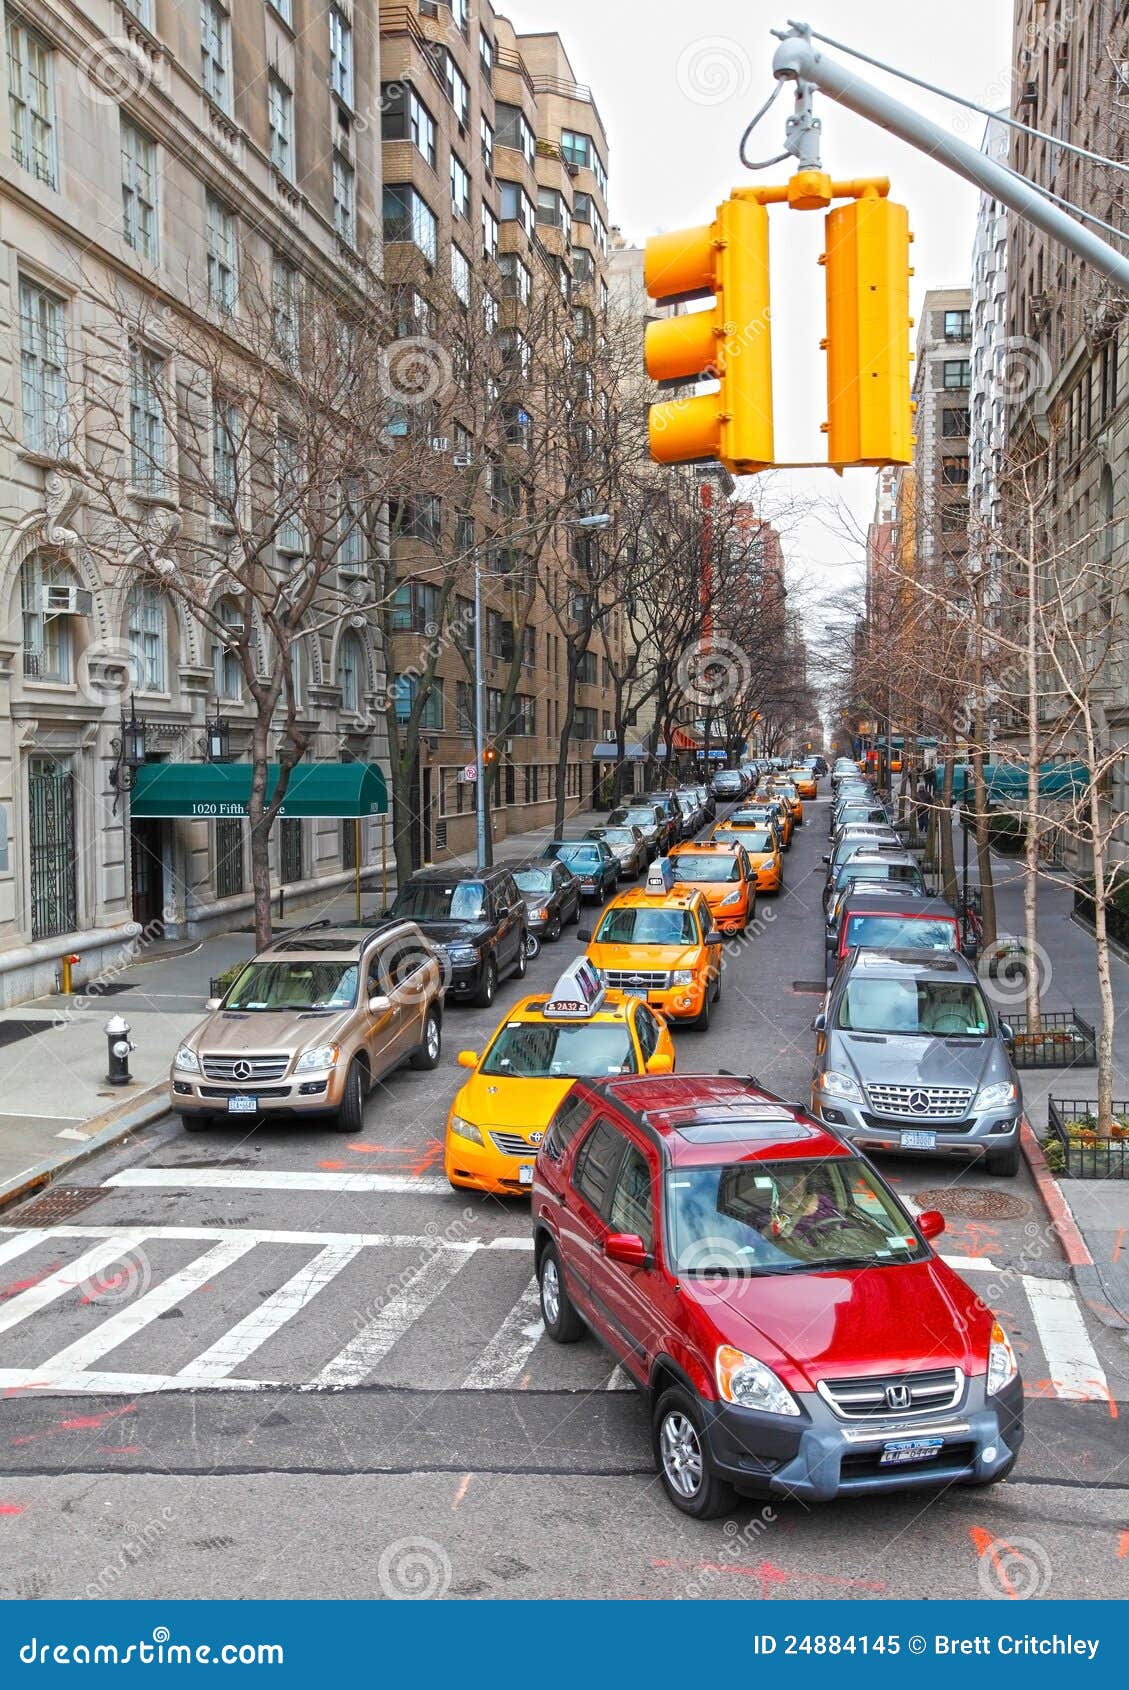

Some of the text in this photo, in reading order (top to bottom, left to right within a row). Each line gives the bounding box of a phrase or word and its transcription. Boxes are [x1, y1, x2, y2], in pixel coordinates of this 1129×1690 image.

[192, 803, 217, 814] 1020
[219, 803, 244, 814] Fifth
[556, 1002, 577, 1011] 2A32
